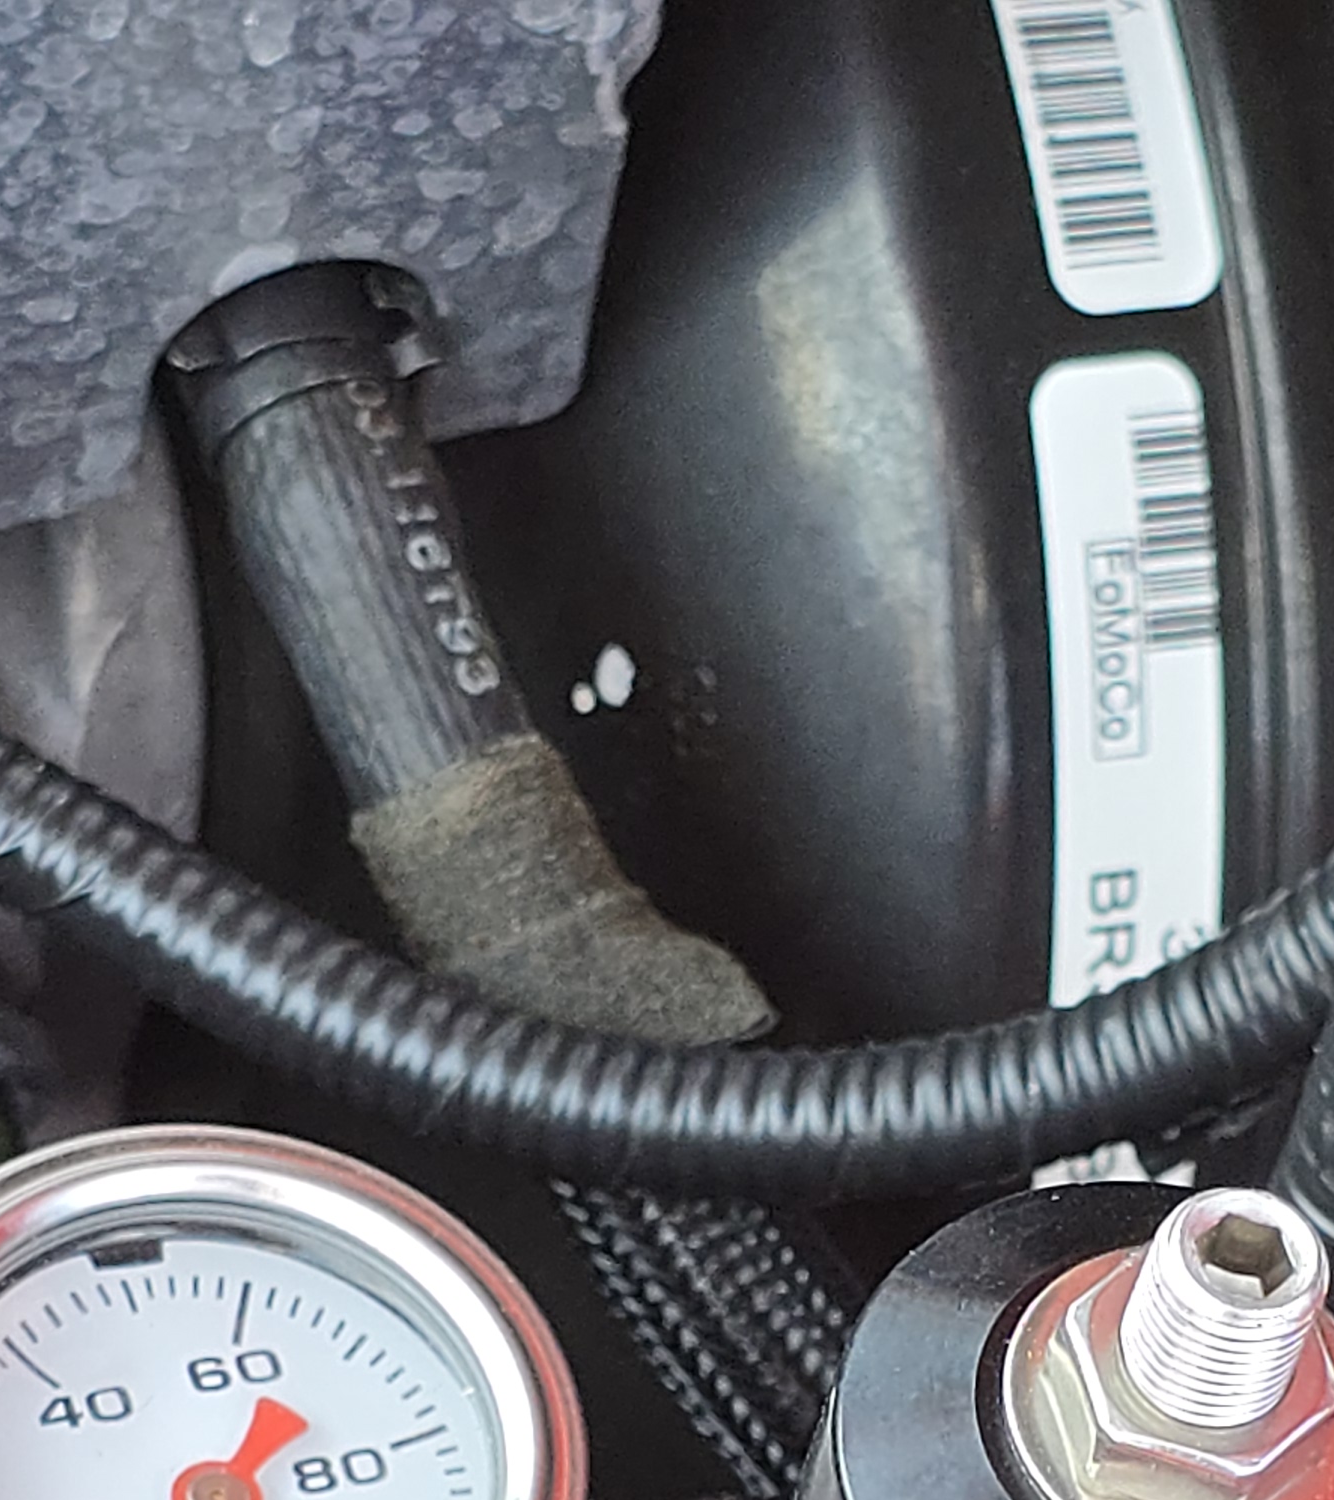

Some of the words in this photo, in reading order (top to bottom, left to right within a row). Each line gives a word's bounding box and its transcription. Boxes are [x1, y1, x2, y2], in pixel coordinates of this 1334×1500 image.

[1090, 548, 1136, 741] FoMoCo
[1088, 868, 1138, 996] BR
[186, 1349, 283, 1392] 60
[39, 1385, 134, 1428] 40
[292, 1447, 388, 1493] 80
